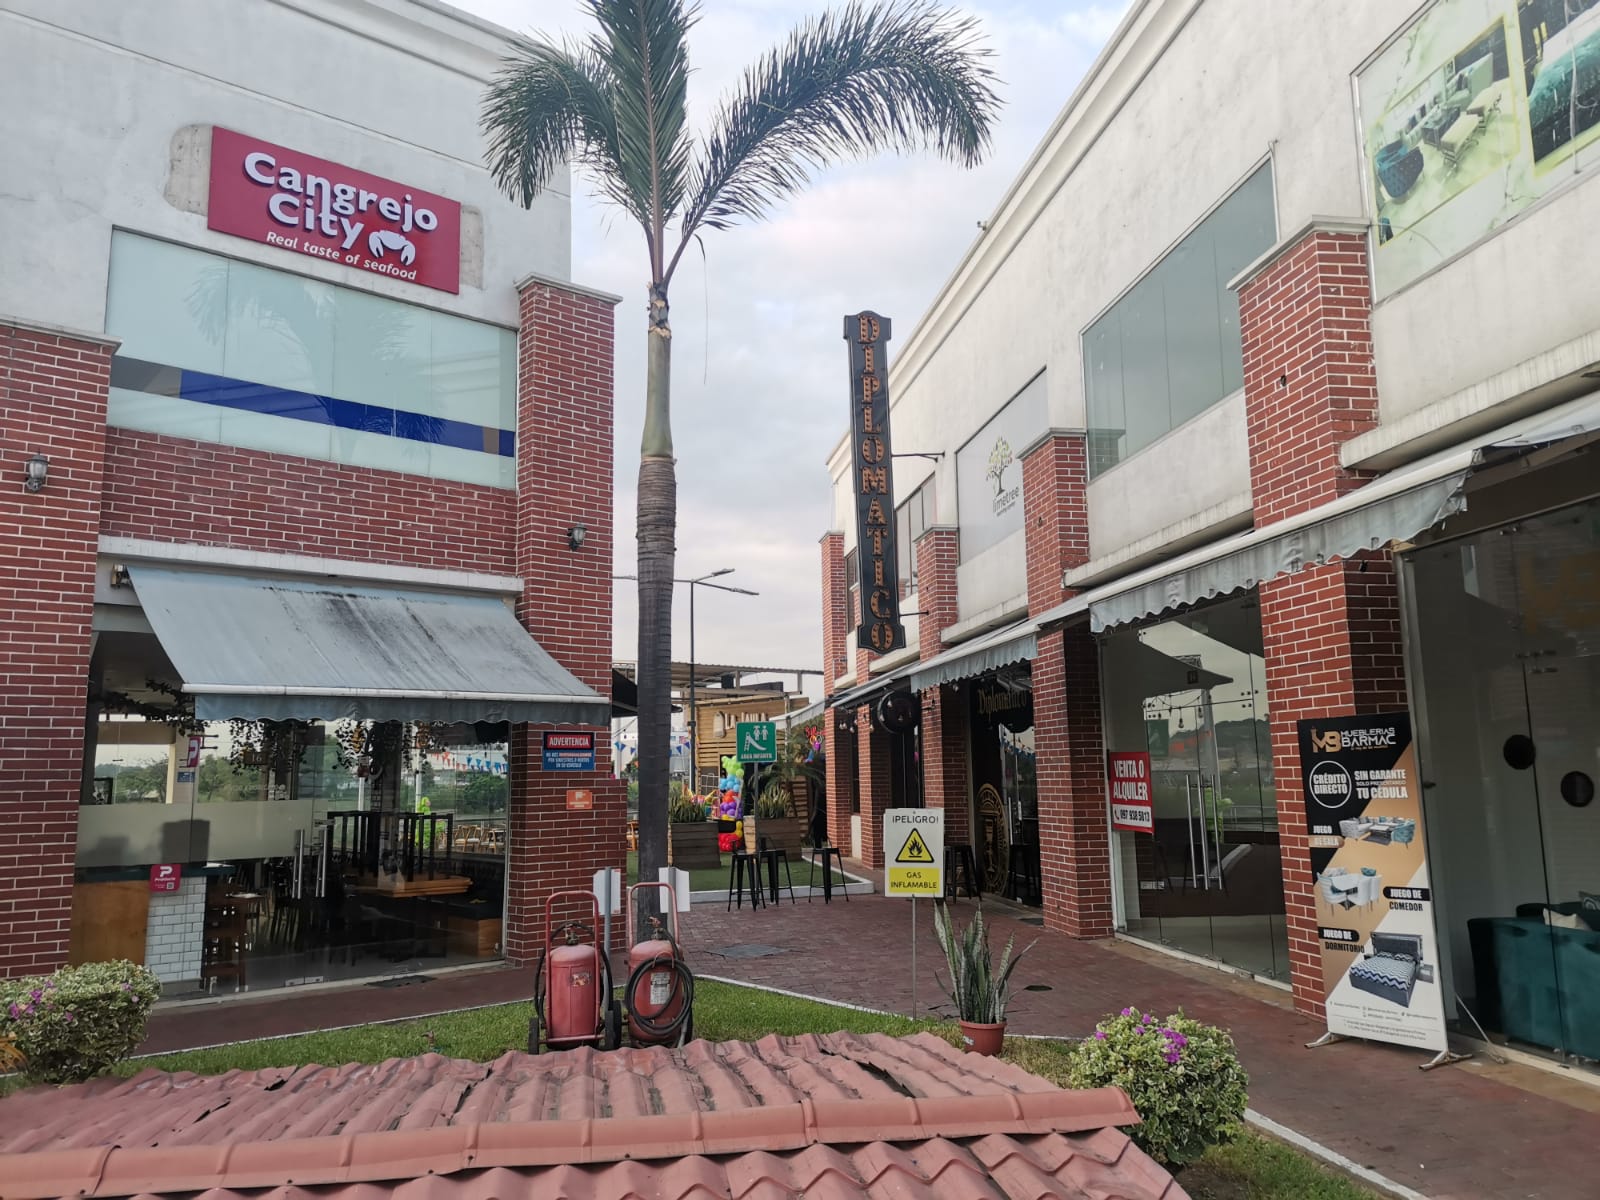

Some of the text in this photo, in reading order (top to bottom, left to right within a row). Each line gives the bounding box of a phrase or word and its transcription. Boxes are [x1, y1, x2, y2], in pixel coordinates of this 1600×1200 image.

[244, 151, 439, 233] Cangrejo
[268, 193, 365, 250] City
[266, 231, 417, 281] Real taste of seafood
[857, 314, 893, 650] DIPLOMATICO
[1340, 727, 1395, 738] MUEBLERIAS
[549, 736, 590, 746] ADVERTENCIA
[1341, 734, 1396, 748] BARMAC
[1114, 759, 1145, 779] VENTA O
[1313, 769, 1407, 785] CRÉDITO SIN GARANTE
[1113, 781, 1149, 801] ALQUILER
[1314, 783, 1348, 795] DIRECTO
[1356, 787, 1369, 800] TU
[1313, 825, 1332, 834] JUEGO
[906, 871, 922, 879] GAS
[890, 881, 938, 889] INFLAMABLE
[1390, 888, 1423, 900] JUEGO DE
[1389, 901, 1424, 912] COMEDOR
[1323, 928, 1353, 940] JUEGO DE
[1325, 941, 1365, 954] DORMITORIO
